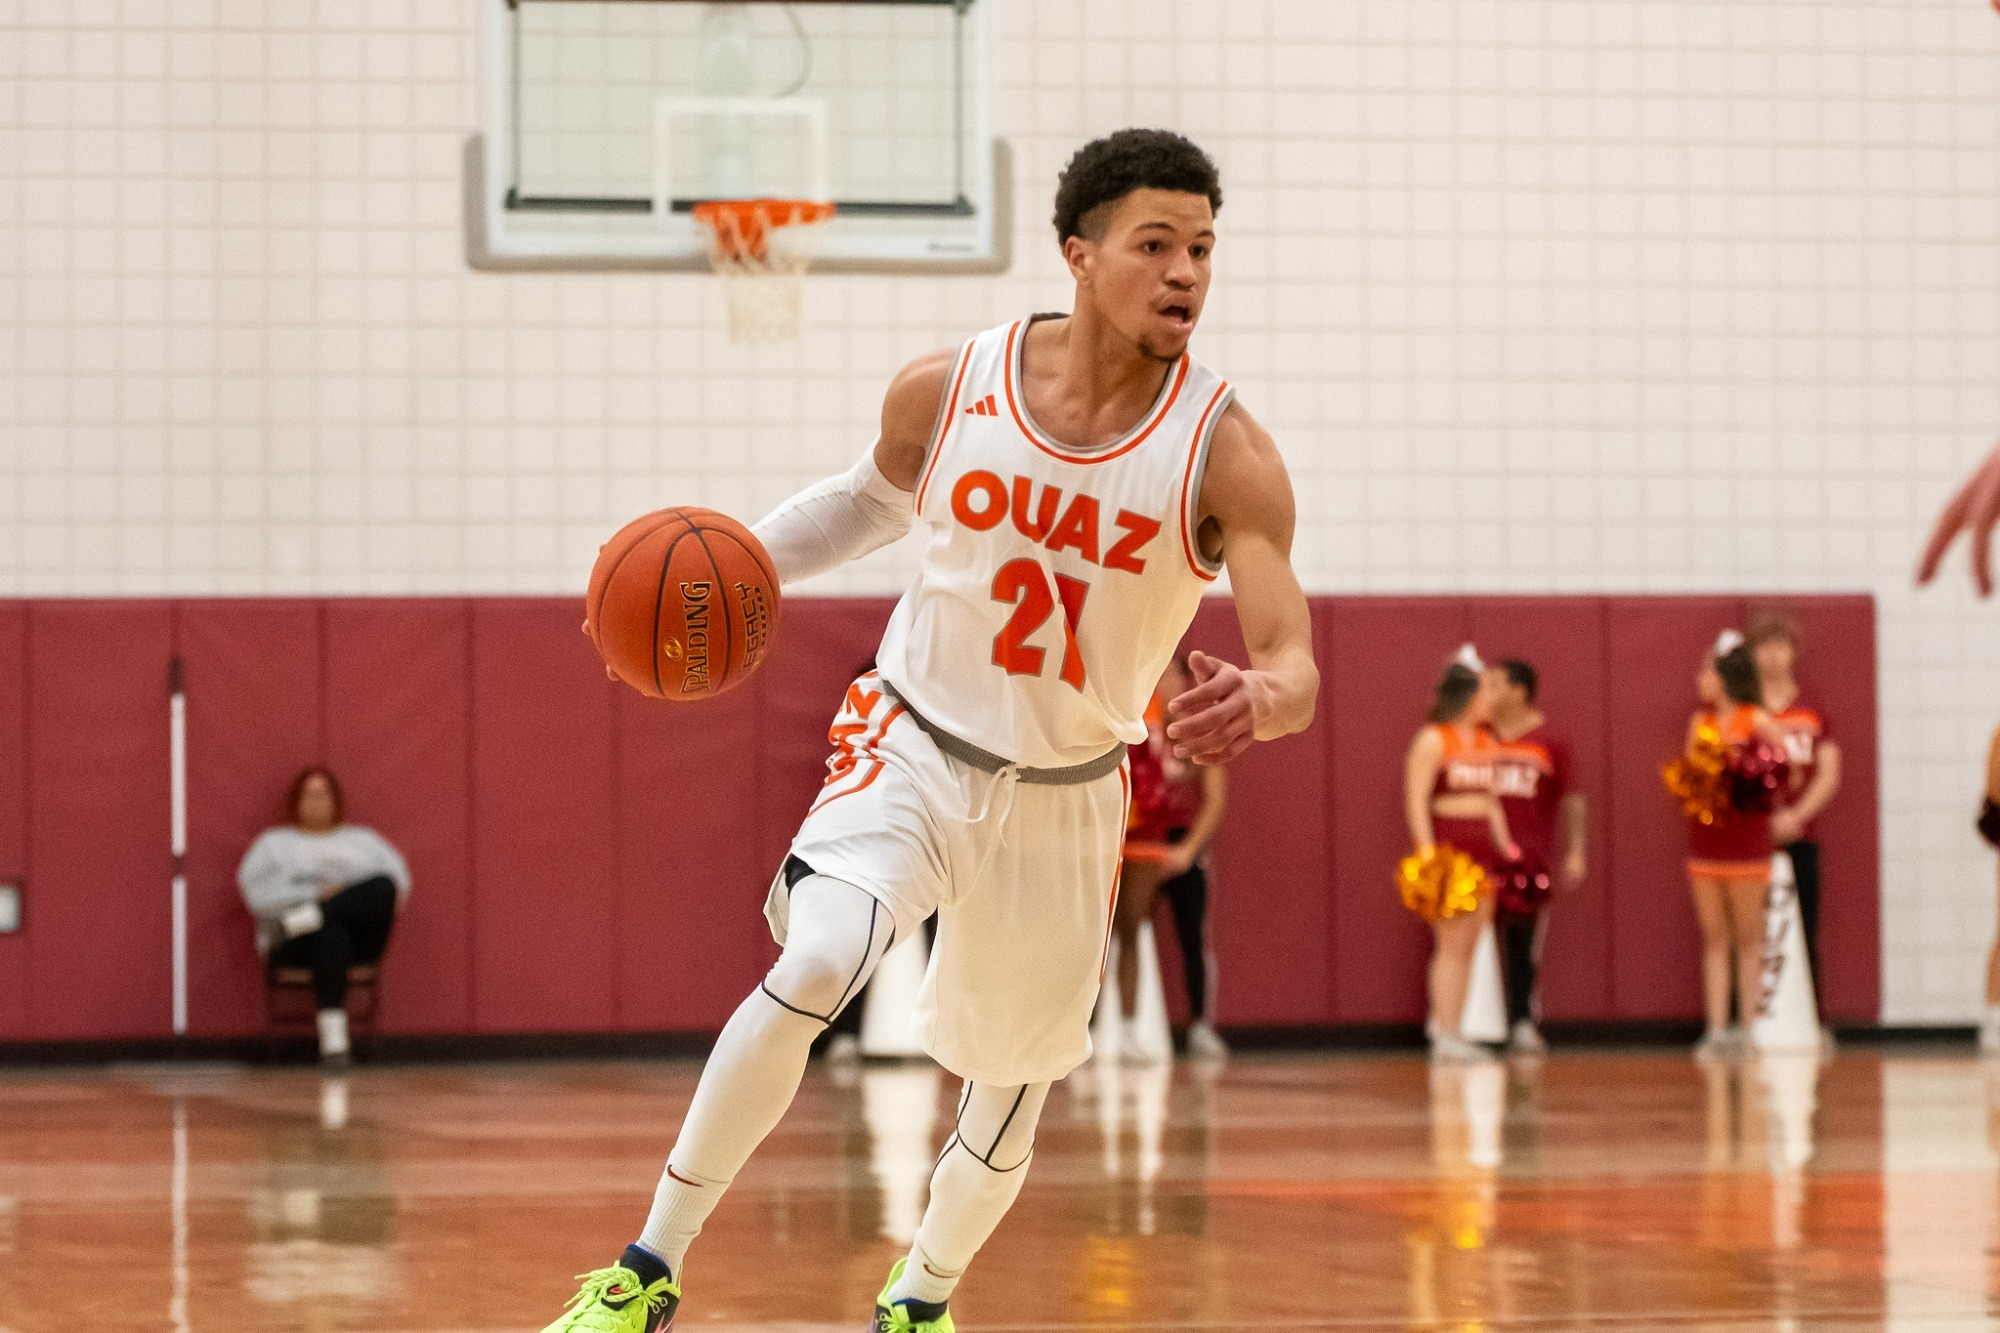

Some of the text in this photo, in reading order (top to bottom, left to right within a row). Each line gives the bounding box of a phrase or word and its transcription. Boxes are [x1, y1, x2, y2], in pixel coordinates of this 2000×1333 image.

[951, 469, 1162, 575] OUAZ
[734, 581, 760, 669] EGACY
[990, 557, 1090, 694] 21
